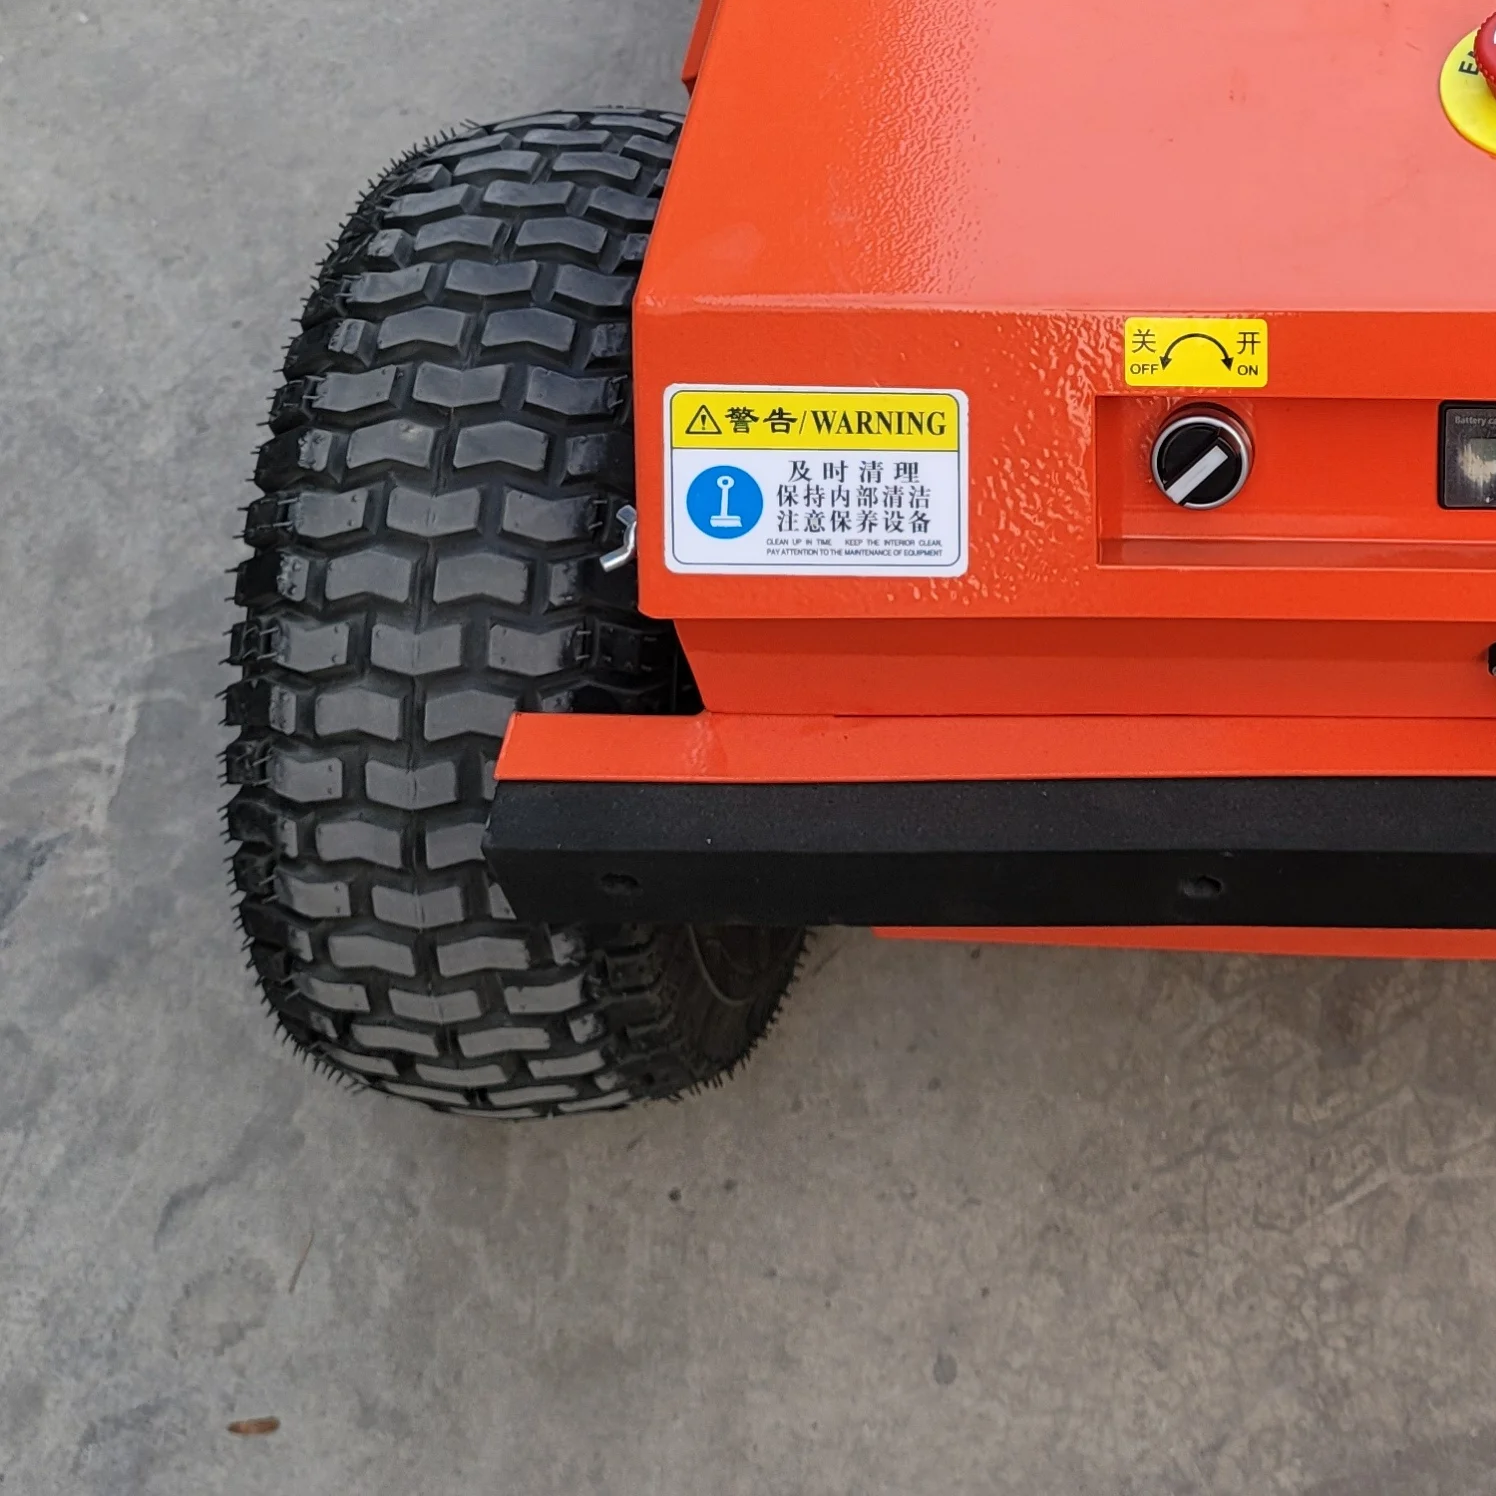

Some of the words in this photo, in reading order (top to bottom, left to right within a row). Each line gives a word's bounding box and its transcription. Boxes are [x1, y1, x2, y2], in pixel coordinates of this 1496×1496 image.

[1132, 328, 1156, 354] 关
[1236, 331, 1261, 355] 开
[1130, 363, 1159, 375] OFF
[1237, 364, 1258, 376] ON
[724, 406, 947, 436] 警告/WARNING
[1454, 416, 1486, 426] Battery
[788, 460, 920, 484] 及时清理
[776, 485, 931, 510] 保持内部清洁
[776, 510, 931, 534] 注意保养设备
[766, 538, 789, 546] CLEAN
[792, 538, 802, 546] UP
[806, 538, 812, 546] IN
[816, 538, 832, 546] TIME
[766, 548, 780, 556] PAY
[780, 548, 818, 556] ATTENTION
[820, 548, 830, 556] TO
